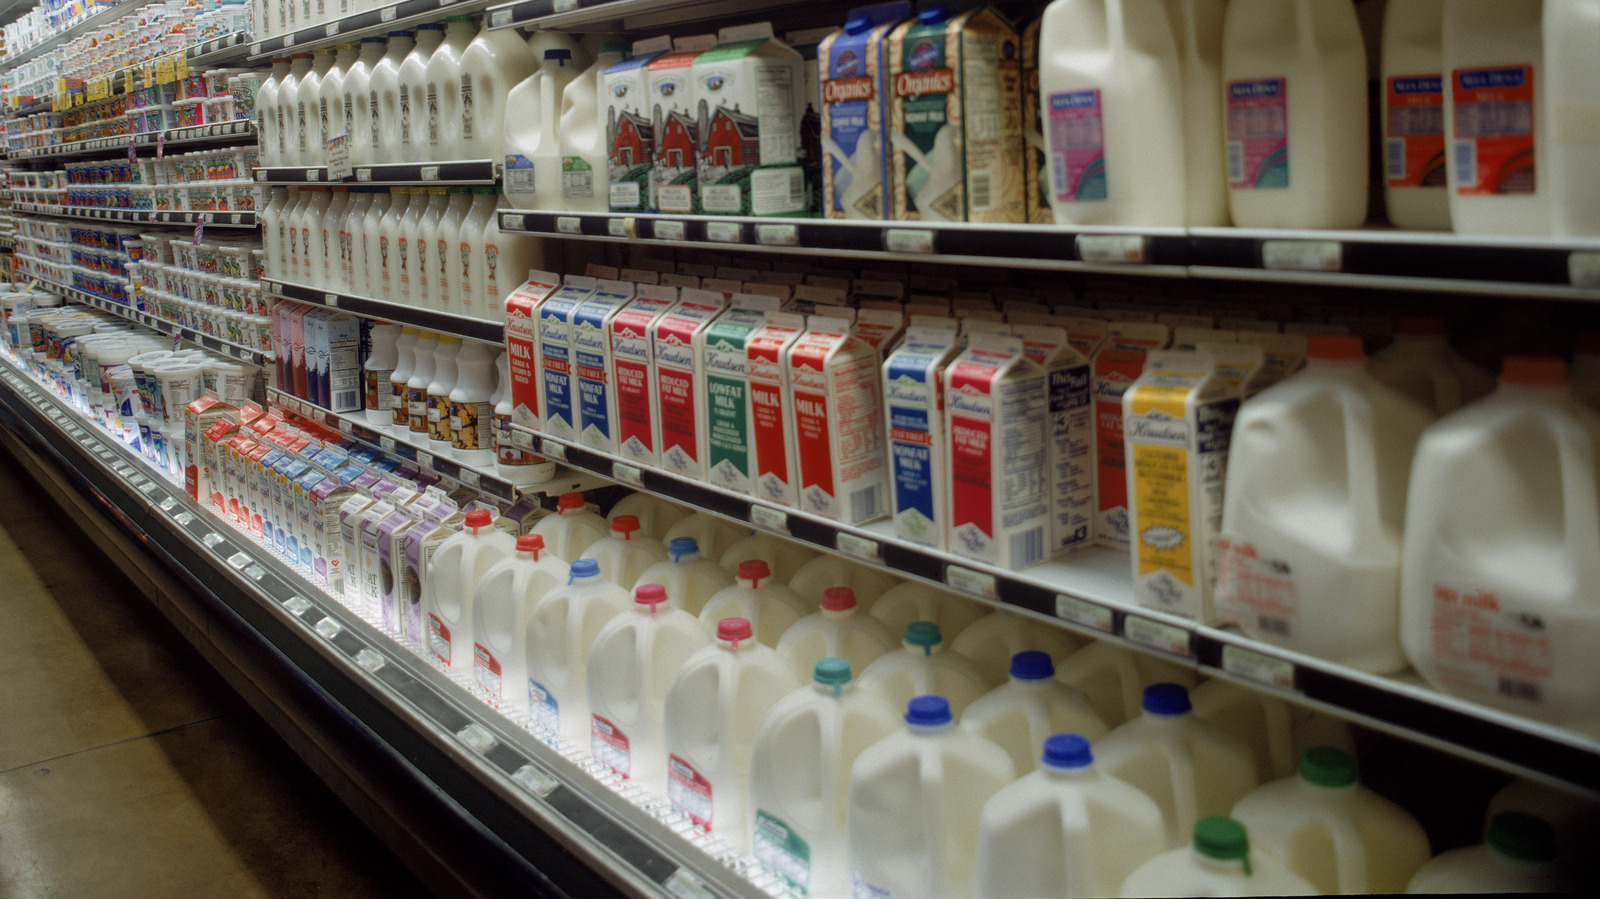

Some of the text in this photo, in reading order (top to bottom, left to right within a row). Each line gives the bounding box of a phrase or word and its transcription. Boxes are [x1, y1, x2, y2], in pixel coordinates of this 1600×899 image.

[825, 80, 871, 106] Organics
[897, 73, 952, 102] Organics
[505, 318, 533, 337] Knudsen
[541, 324, 569, 342] Knudsen
[575, 331, 604, 349] Knudsen
[613, 338, 647, 358] Knudsen
[510, 342, 530, 360] MILK
[657, 345, 692, 367] Knudsen
[705, 352, 745, 373] Knudsen
[545, 372, 566, 386] NONFAT
[618, 366, 644, 379] REDUCED
[747, 364, 779, 380] Knudsen
[548, 382, 562, 395] MILK
[580, 382, 603, 396] NONFAT
[619, 375, 642, 388] FAT MILK
[661, 374, 689, 388] REDUCED
[793, 374, 826, 390] Knudsen
[583, 392, 598, 405] MILK
[662, 384, 688, 398] FAT MILK
[709, 382, 742, 399] LOWFAT
[752, 389, 780, 408] MILK
[887, 386, 928, 402] Knudsen
[714, 395, 736, 409] MILK
[796, 398, 825, 418] MILK
[950, 394, 991, 416] Knudsen
[953, 425, 988, 440] REDUCED
[1129, 421, 1186, 440] Knudsen
[955, 434, 987, 450] FAT MILK
[894, 444, 928, 460] NONFAT
[900, 458, 922, 470] MILK
